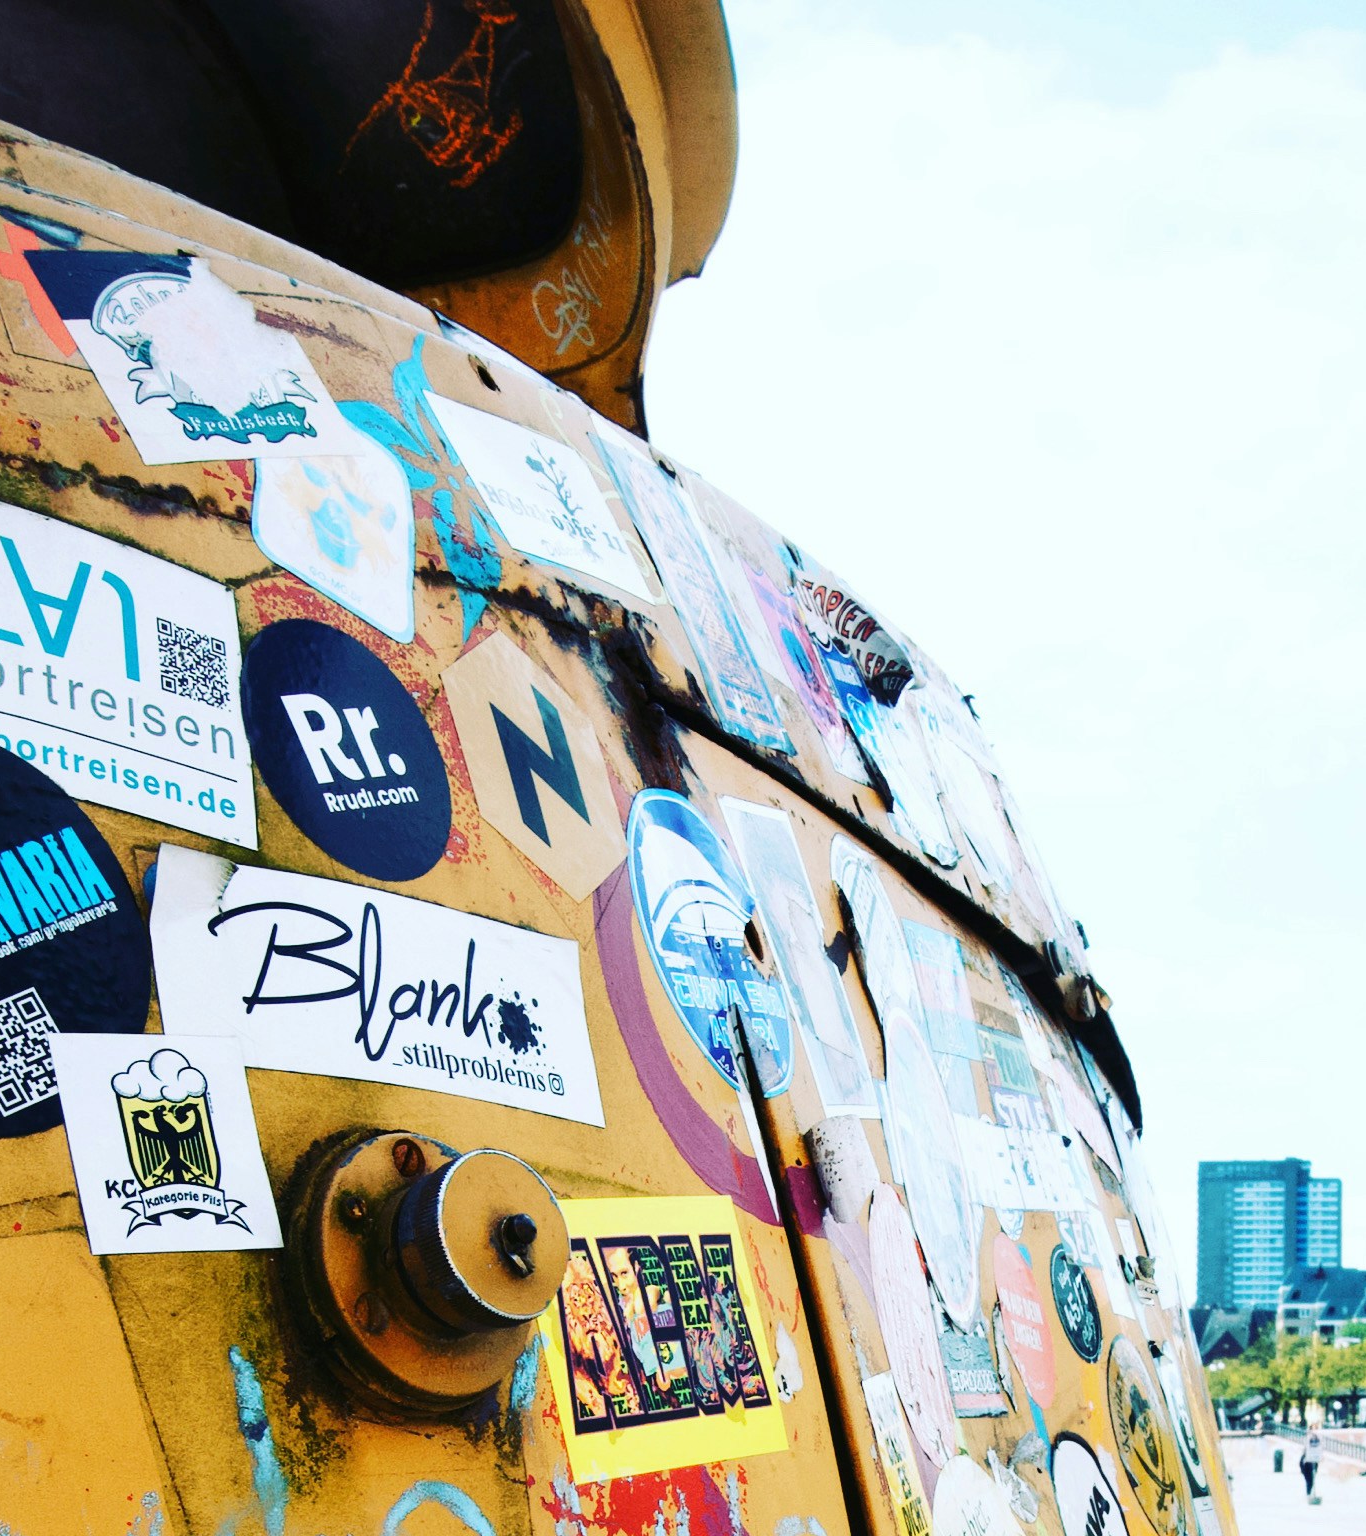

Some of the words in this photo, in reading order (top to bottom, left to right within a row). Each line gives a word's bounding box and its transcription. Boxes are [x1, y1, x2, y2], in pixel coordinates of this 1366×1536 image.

[280, 692, 407, 786] Rr.
[207, 900, 494, 1063] Blank
[105, 1178, 137, 1199] KC
[145, 1190, 200, 1209] Kategorie
[202, 1191, 222, 1207] Pils
